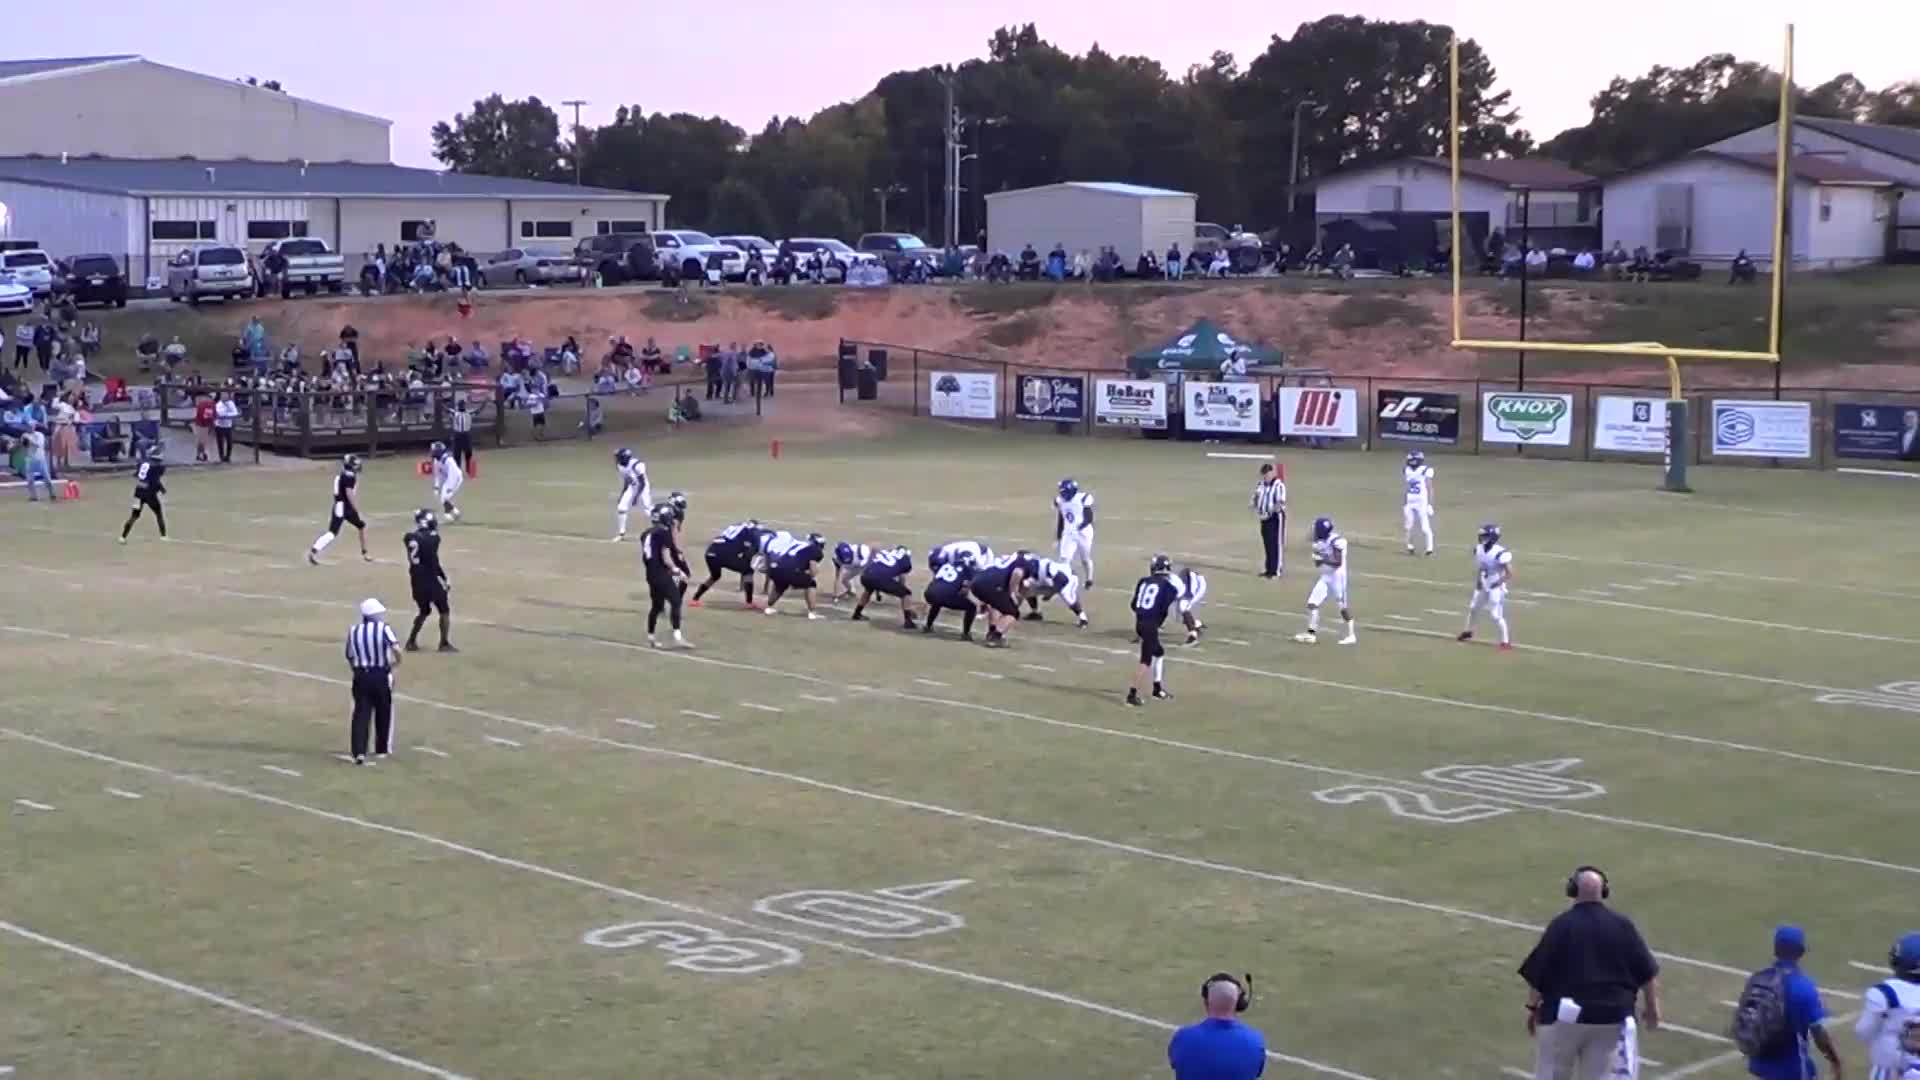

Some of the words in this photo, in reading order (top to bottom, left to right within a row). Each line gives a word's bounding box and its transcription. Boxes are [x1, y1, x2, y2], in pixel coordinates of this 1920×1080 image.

[1497, 400, 1559, 414] KNOX
[408, 540, 420, 564] 2
[1136, 583, 1159, 609] 18
[1311, 764, 1607, 823] 20
[583, 889, 965, 972] 30
